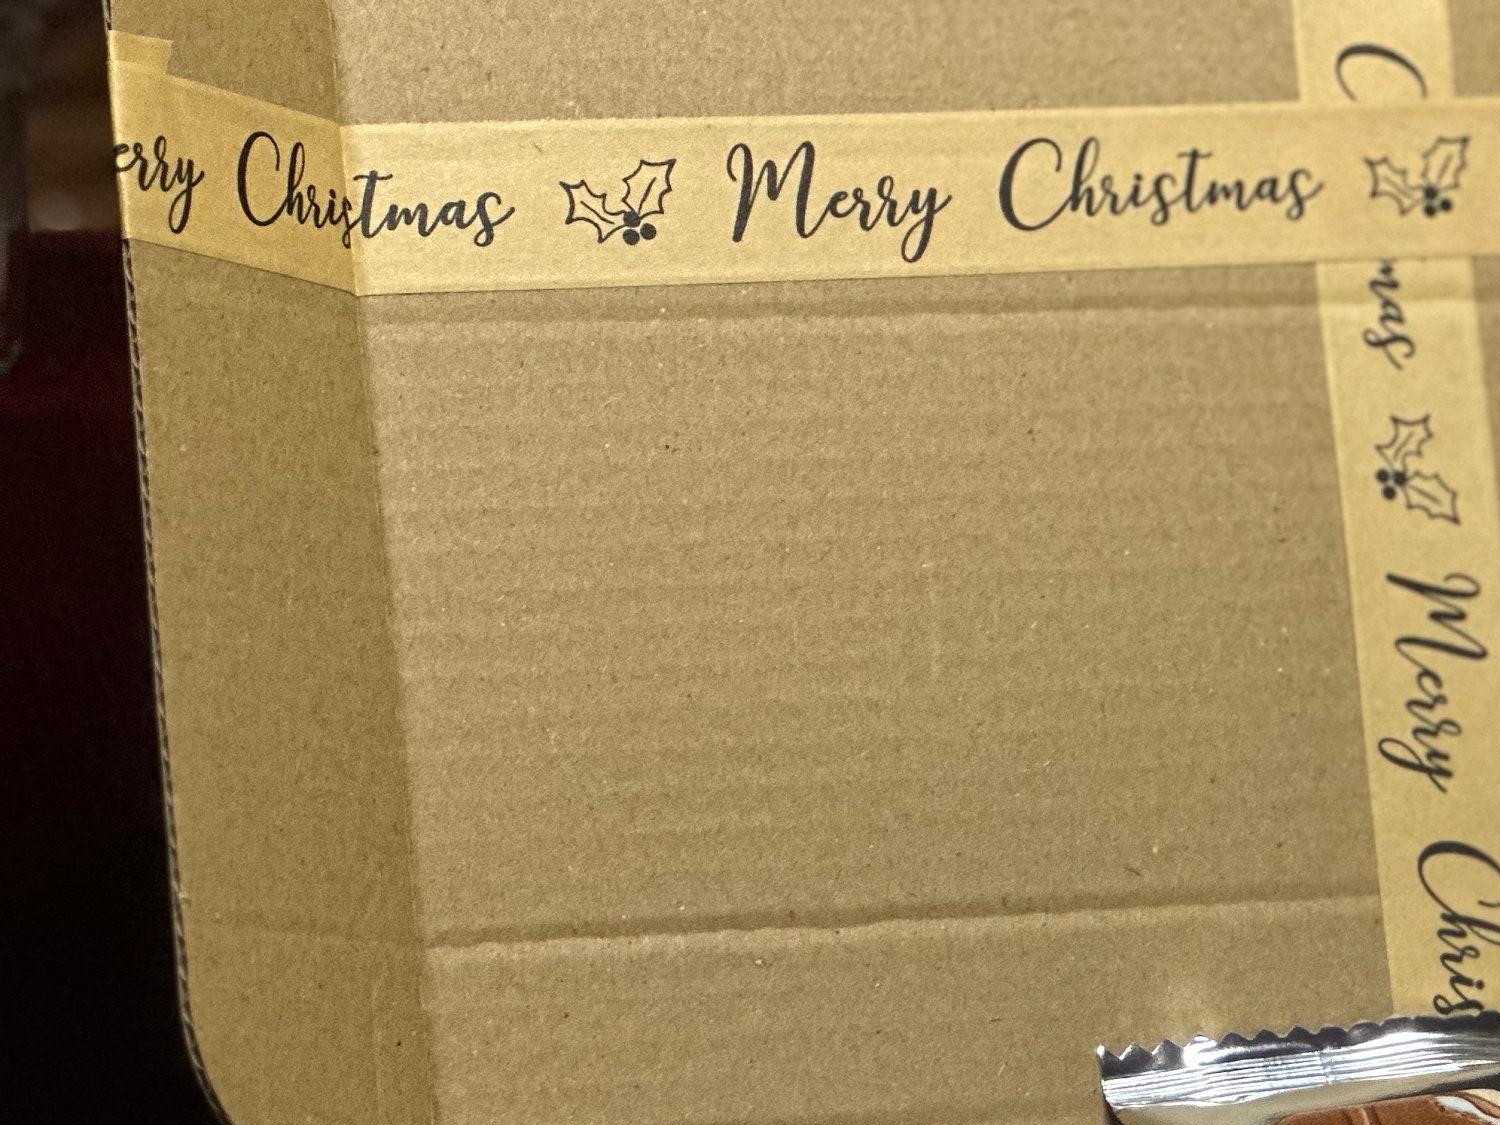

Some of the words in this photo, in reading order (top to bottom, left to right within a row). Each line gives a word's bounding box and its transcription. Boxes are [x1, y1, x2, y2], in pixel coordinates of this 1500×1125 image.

[113, 135, 206, 235] erry
[237, 130, 515, 249] Christmas
[726, 140, 953, 265] Merry
[999, 136, 1327, 232] Christmas
[1377, 571, 1489, 794] Merry
